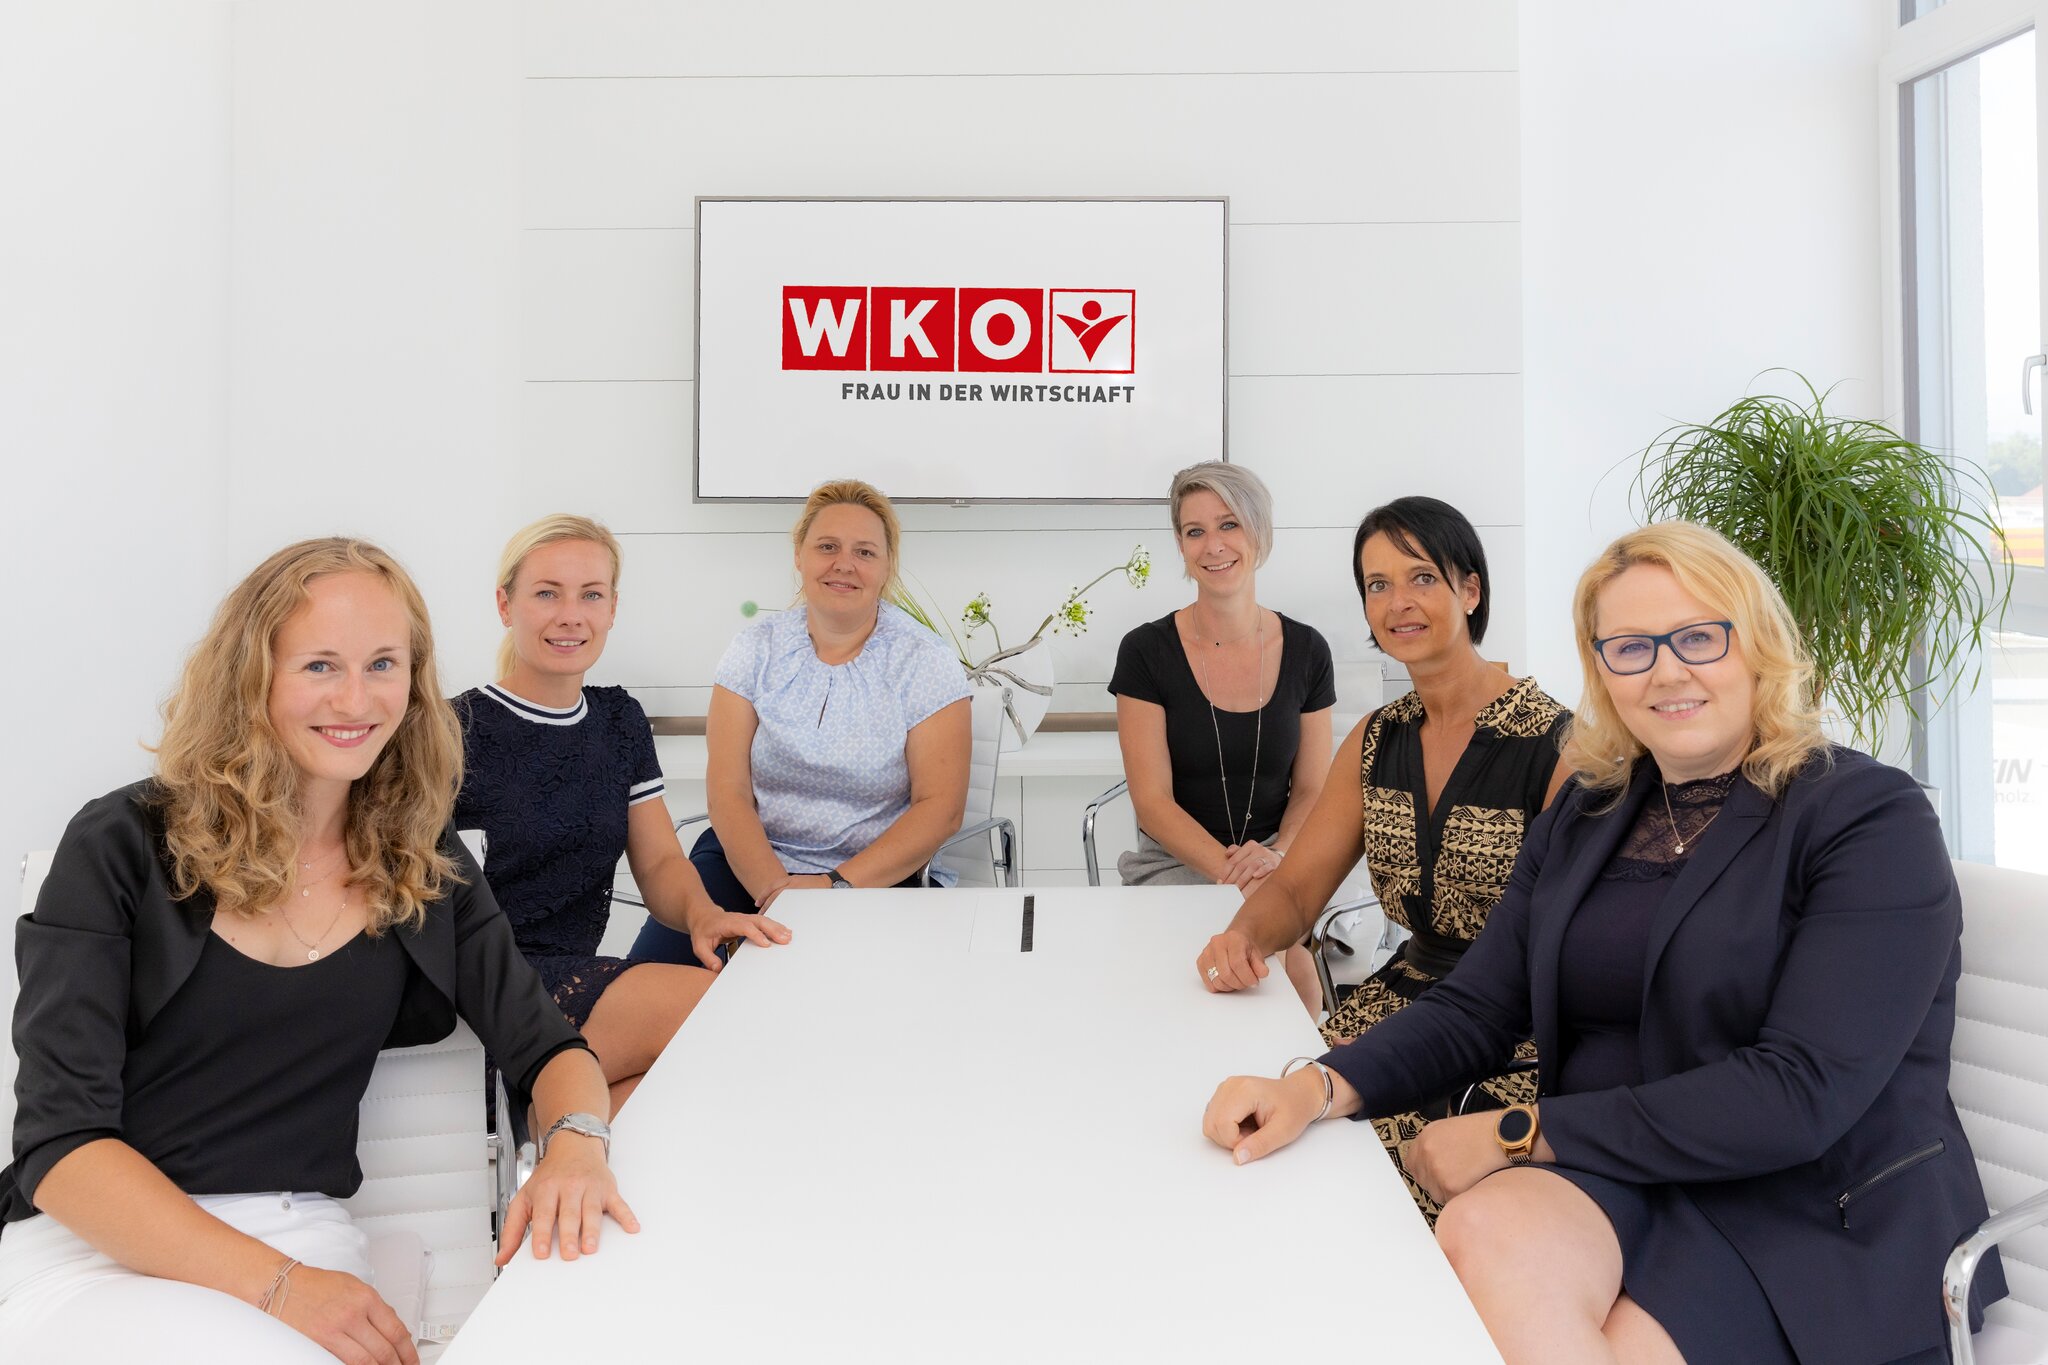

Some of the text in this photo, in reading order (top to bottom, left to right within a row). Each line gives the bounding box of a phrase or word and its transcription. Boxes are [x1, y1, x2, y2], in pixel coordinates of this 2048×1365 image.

[788, 298, 1032, 360] WKO
[842, 383, 1135, 403] FRAU IN DER WIRTSCHAFT
[1993, 758, 2032, 783] IN
